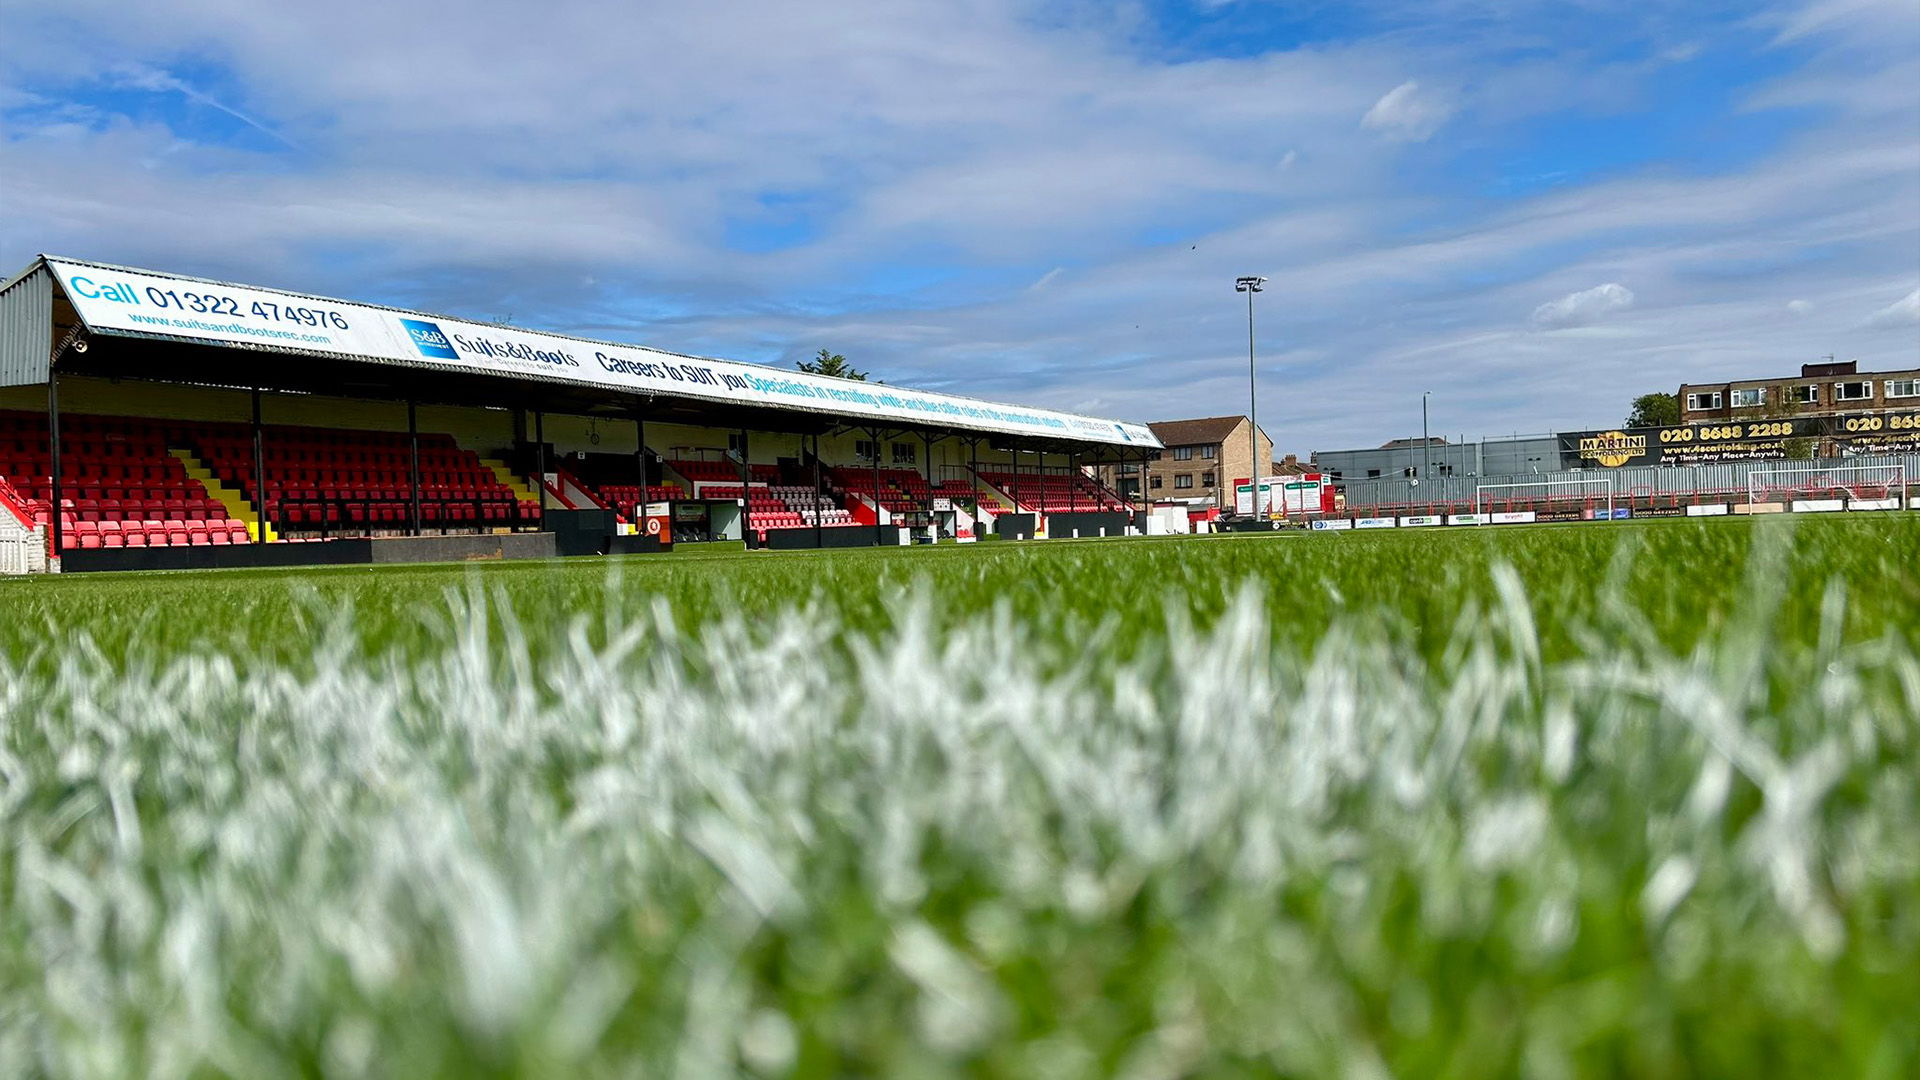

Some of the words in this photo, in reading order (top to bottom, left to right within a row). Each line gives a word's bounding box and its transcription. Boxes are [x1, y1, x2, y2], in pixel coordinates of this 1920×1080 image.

[71, 276, 141, 305] Call
[146, 287, 245, 318] 01322
[251, 302, 349, 331] 474976
[128, 312, 331, 345] www.suitsandbootsrec.com
[410, 329, 446, 345] S&B
[454, 334, 579, 367] Suits&Boots
[595, 351, 666, 379] Careers
[661, 362, 684, 381] to
[680, 364, 719, 386] SUIT
[717, 372, 749, 391] you
[744, 373, 815, 398] Specialists
[811, 383, 827, 400] in
[825, 388, 880, 409] recruiting
[1660, 428, 1693, 443] 020
[1700, 425, 1742, 440] 8688
[1748, 422, 1793, 437] 2288
[1846, 417, 1883, 432] 020
[1582, 436, 1644, 450] MARTINI
[1849, 445, 1866, 453] Any
[1660, 455, 1676, 463] Any
